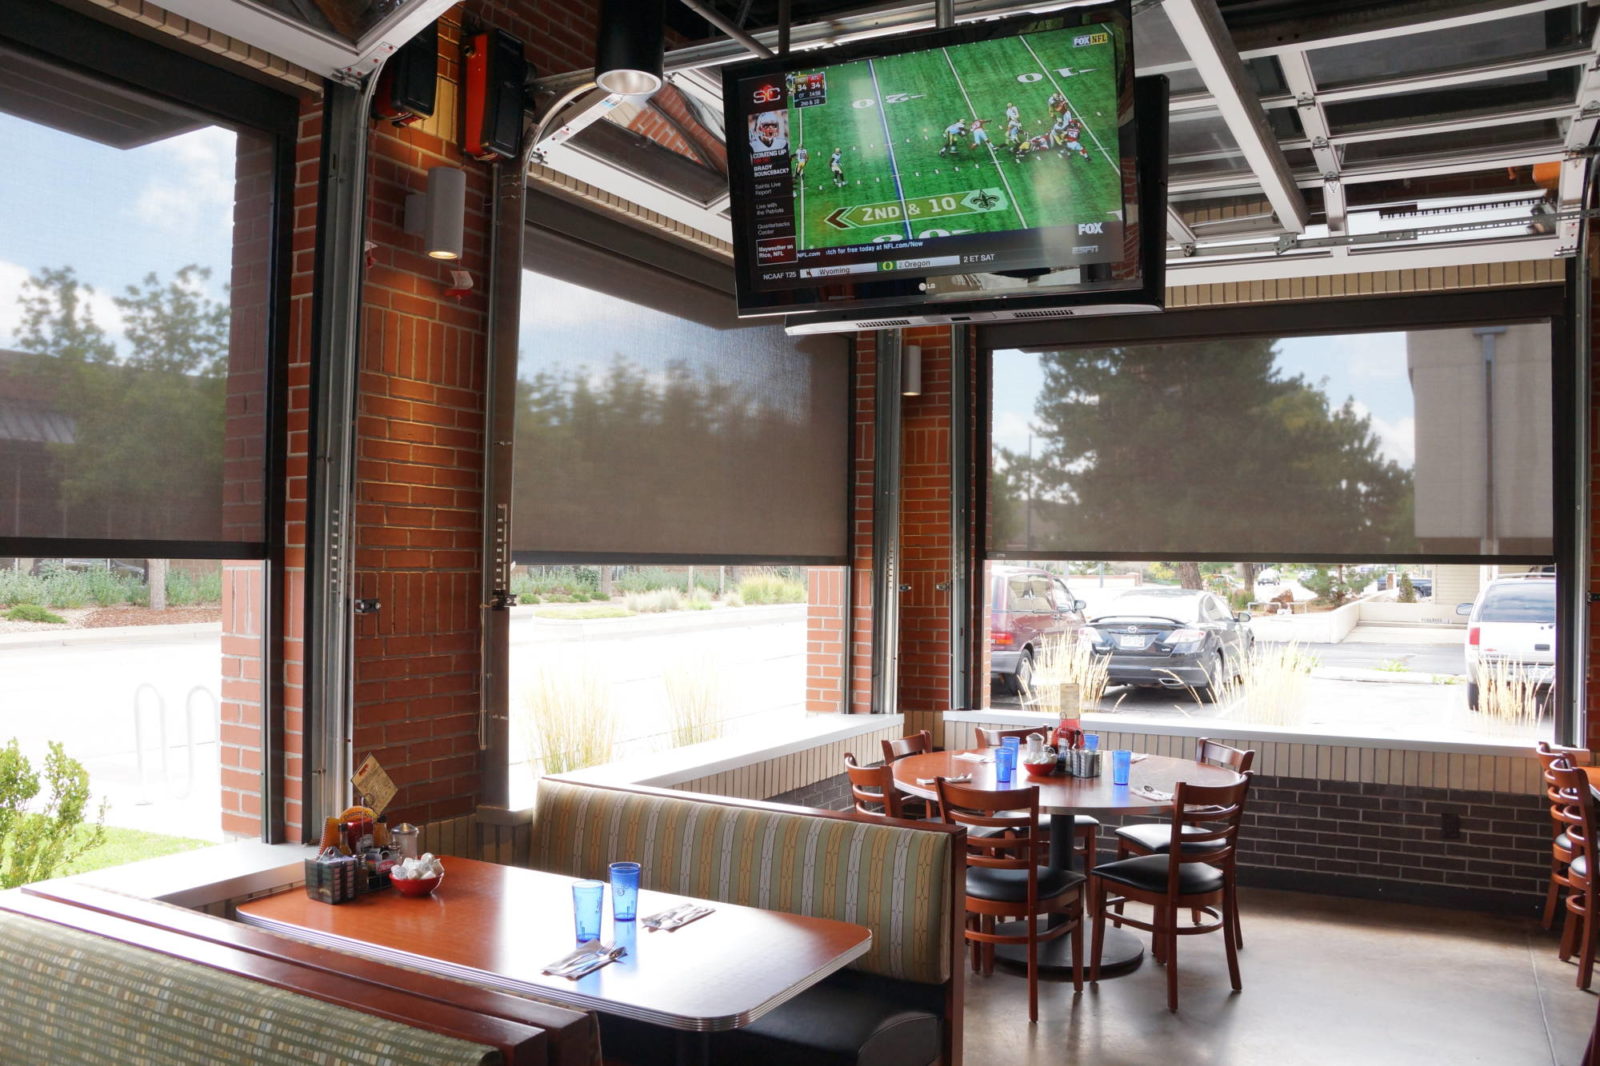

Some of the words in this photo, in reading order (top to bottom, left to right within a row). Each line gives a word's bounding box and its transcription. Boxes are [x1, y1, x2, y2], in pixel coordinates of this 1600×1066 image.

[1073, 35, 1090, 47] FOX
[753, 87, 780, 104] SC
[753, 150, 778, 158] COMING
[861, 206, 900, 222] 2ND
[908, 204, 920, 216] &
[929, 196, 956, 213] 10
[1078, 222, 1104, 236] FOX
[884, 241, 924, 250] NFL.com/Now
[980, 253, 995, 261] SAT
[904, 259, 930, 269] Oregon
[763, 272, 785, 280] NCAAF
[818, 266, 850, 276] Wyoming
